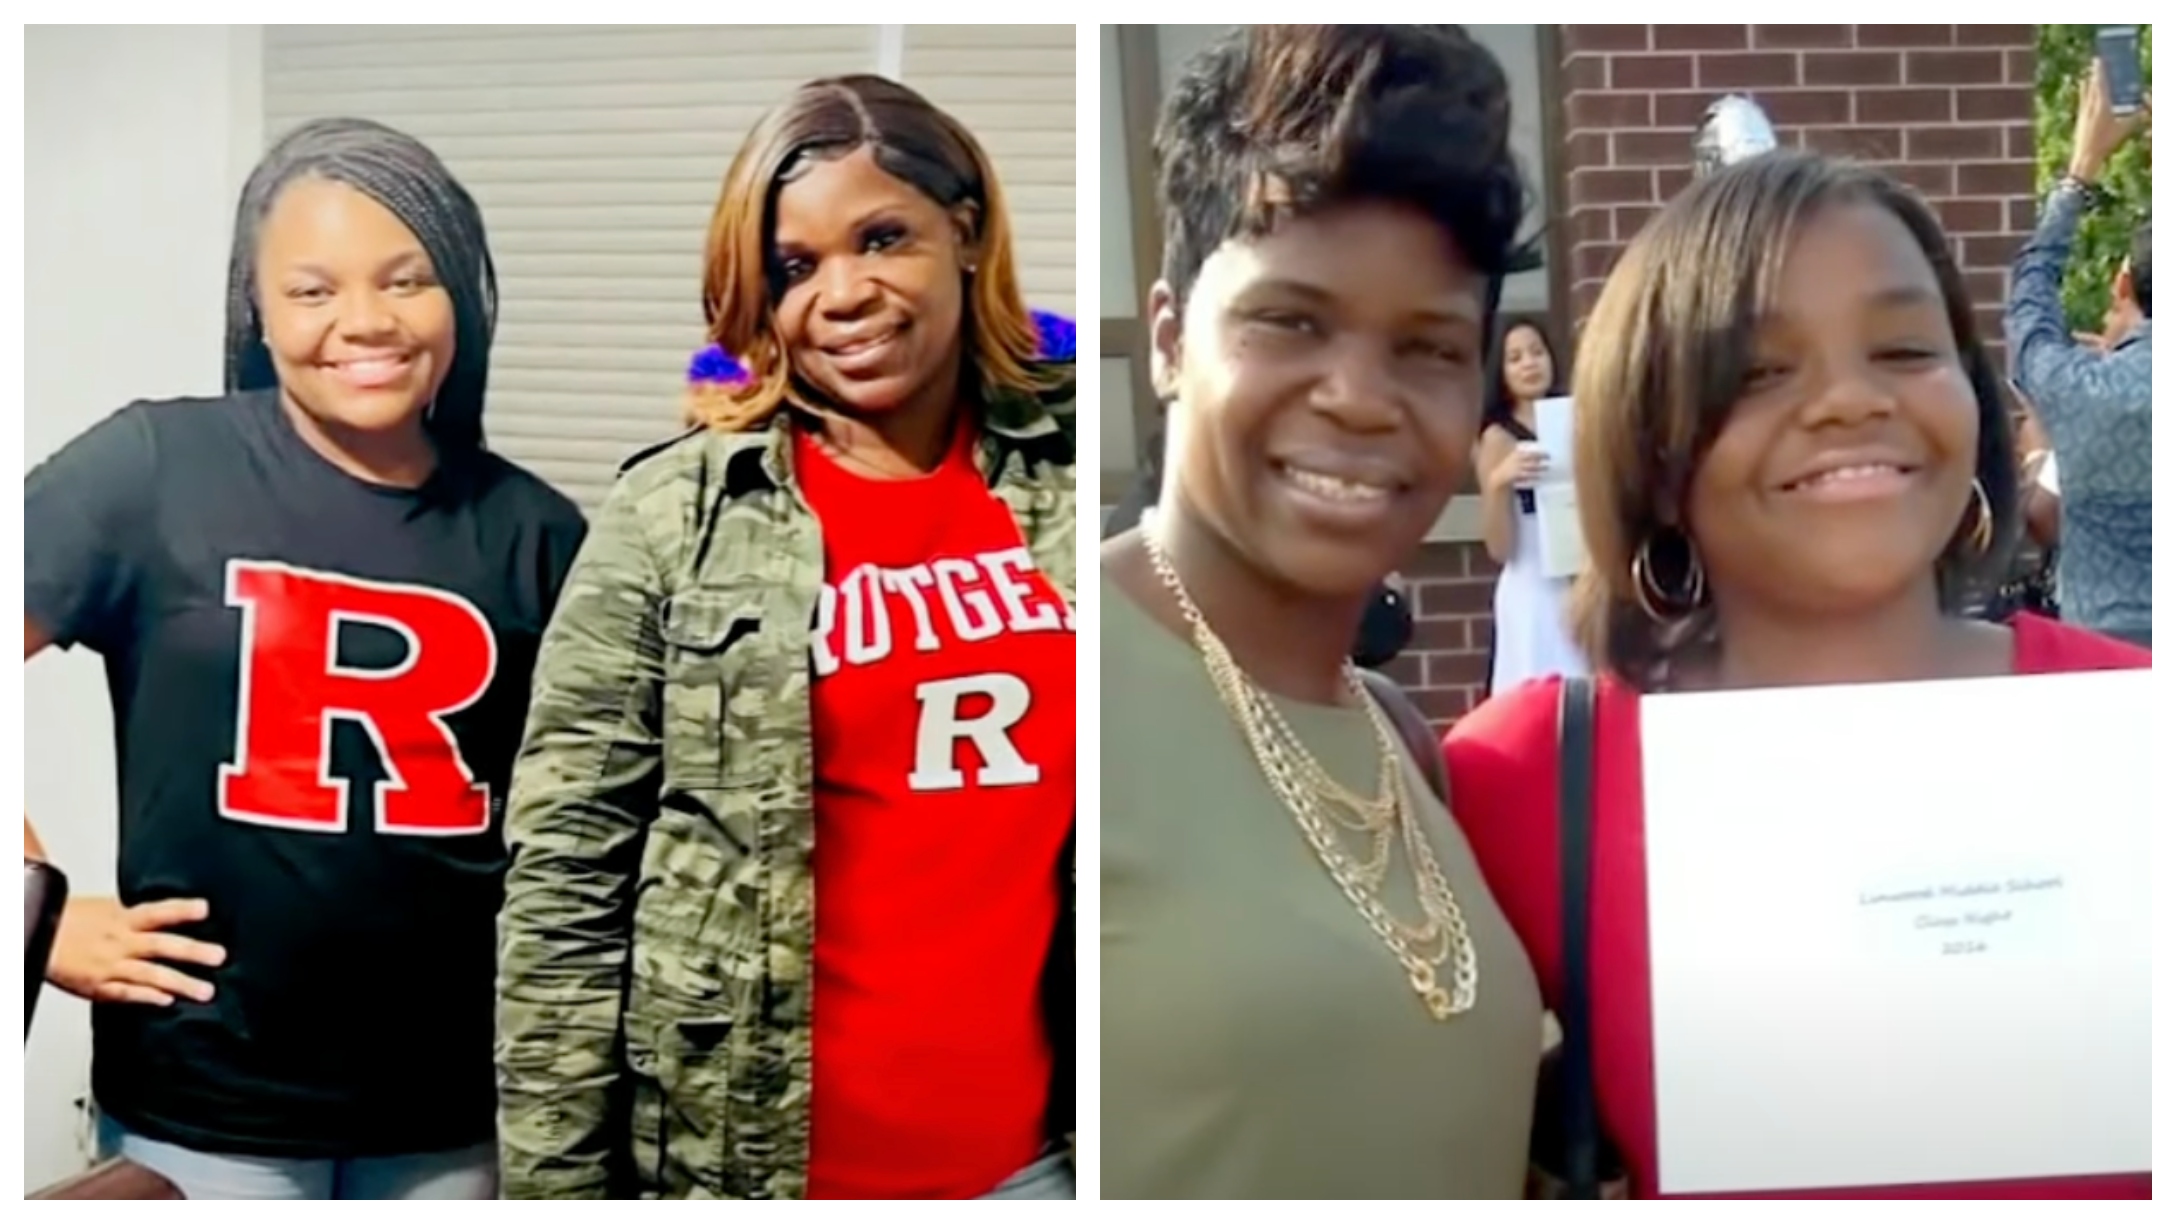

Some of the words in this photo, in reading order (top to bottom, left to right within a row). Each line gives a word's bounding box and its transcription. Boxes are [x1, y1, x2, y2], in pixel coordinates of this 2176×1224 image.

[809, 546, 1076, 676] RUTGE
[218, 559, 497, 836] R
[908, 672, 1039, 790] R
[2005, 875, 2063, 893] School
